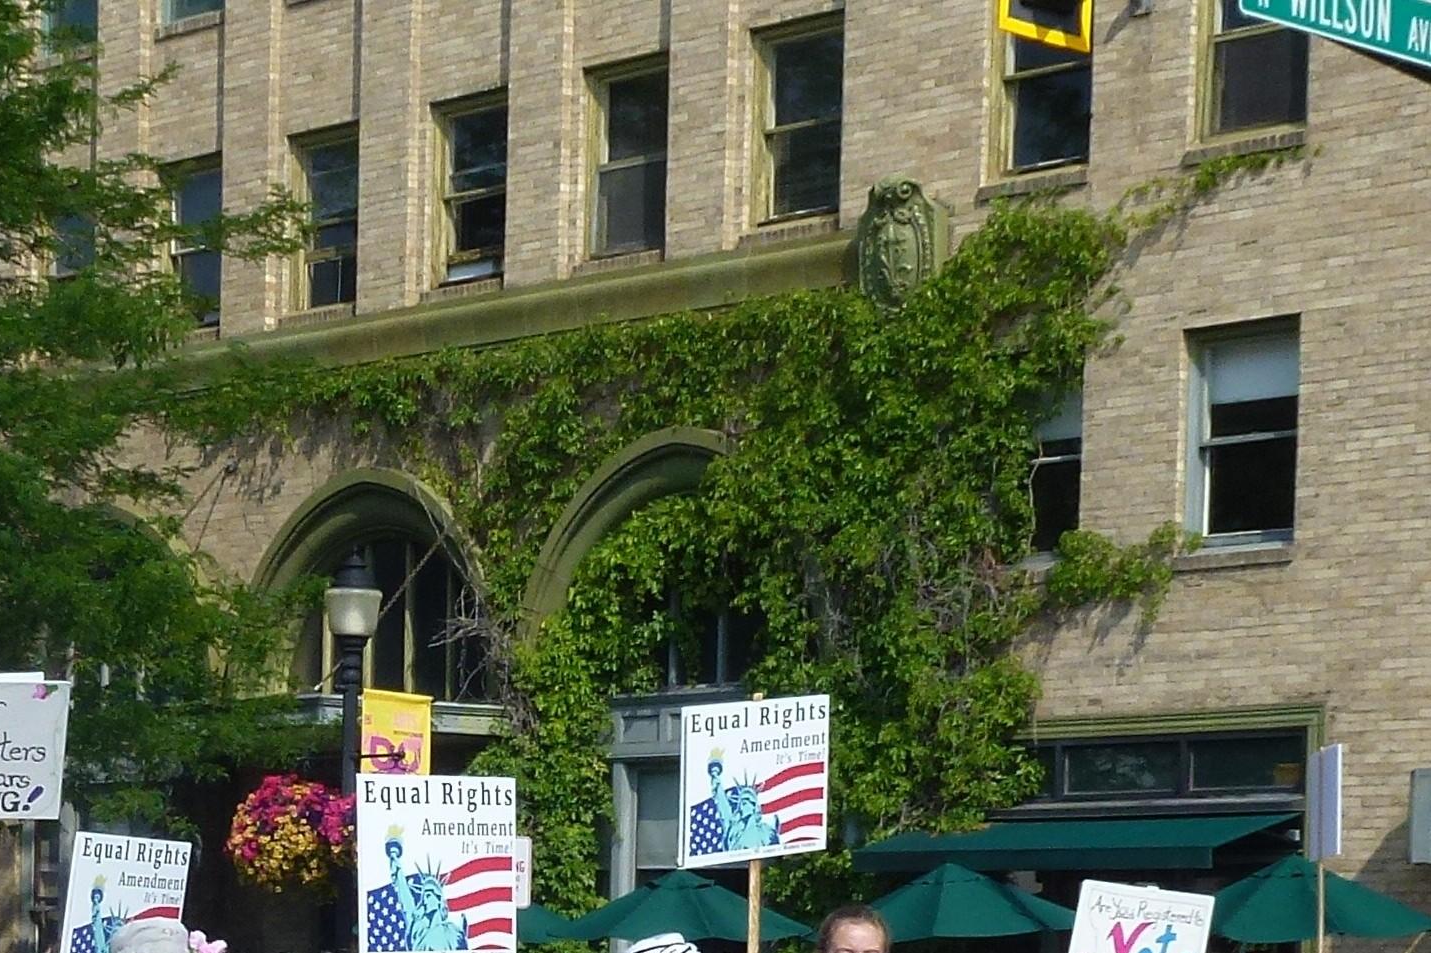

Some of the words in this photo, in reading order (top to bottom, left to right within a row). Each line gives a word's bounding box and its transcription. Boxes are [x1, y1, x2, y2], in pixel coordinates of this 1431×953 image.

[1407, 16, 1431, 56] AV
[691, 706, 749, 737] Equal
[760, 701, 826, 729] Rights
[739, 730, 826, 754] Amendment
[776, 752, 792, 765] It's
[364, 780, 430, 810] Equal
[442, 780, 513, 812] Rights
[421, 817, 514, 837] Amendment
[82, 837, 130, 864] Equal
[136, 842, 188, 869] Rights
[462, 840, 479, 854] It's
[118, 871, 185, 891] Amendment
